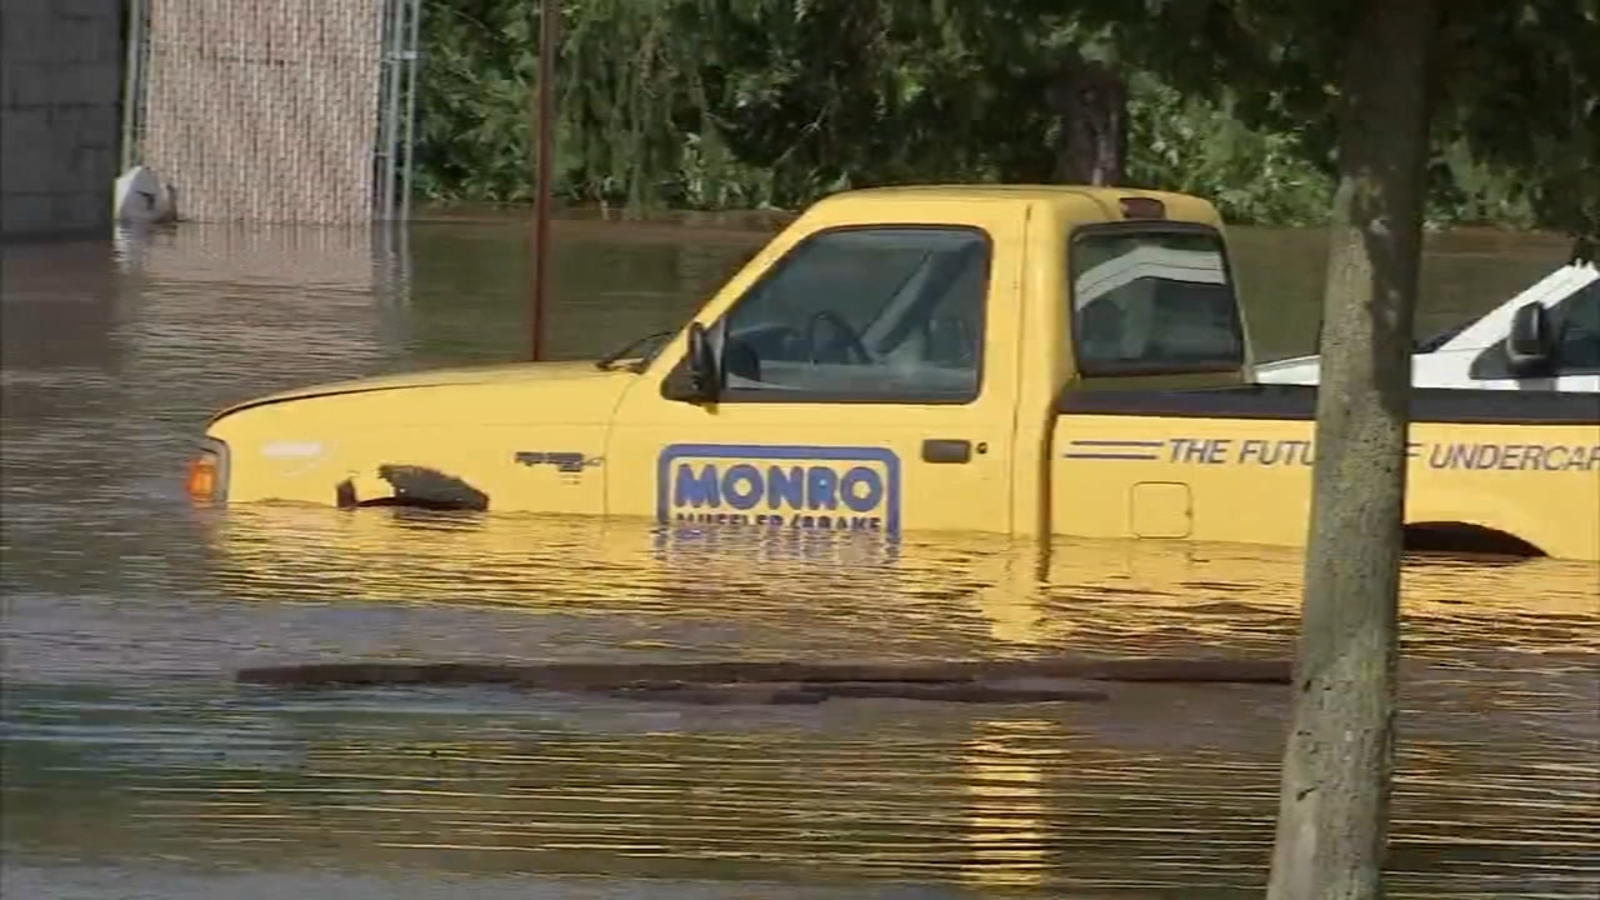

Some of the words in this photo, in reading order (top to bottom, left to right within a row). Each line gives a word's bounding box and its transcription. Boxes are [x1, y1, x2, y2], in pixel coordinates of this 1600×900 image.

[1169, 438, 1232, 464] THE
[1237, 439, 1316, 466] FUTU
[674, 463, 883, 512] MONRO
